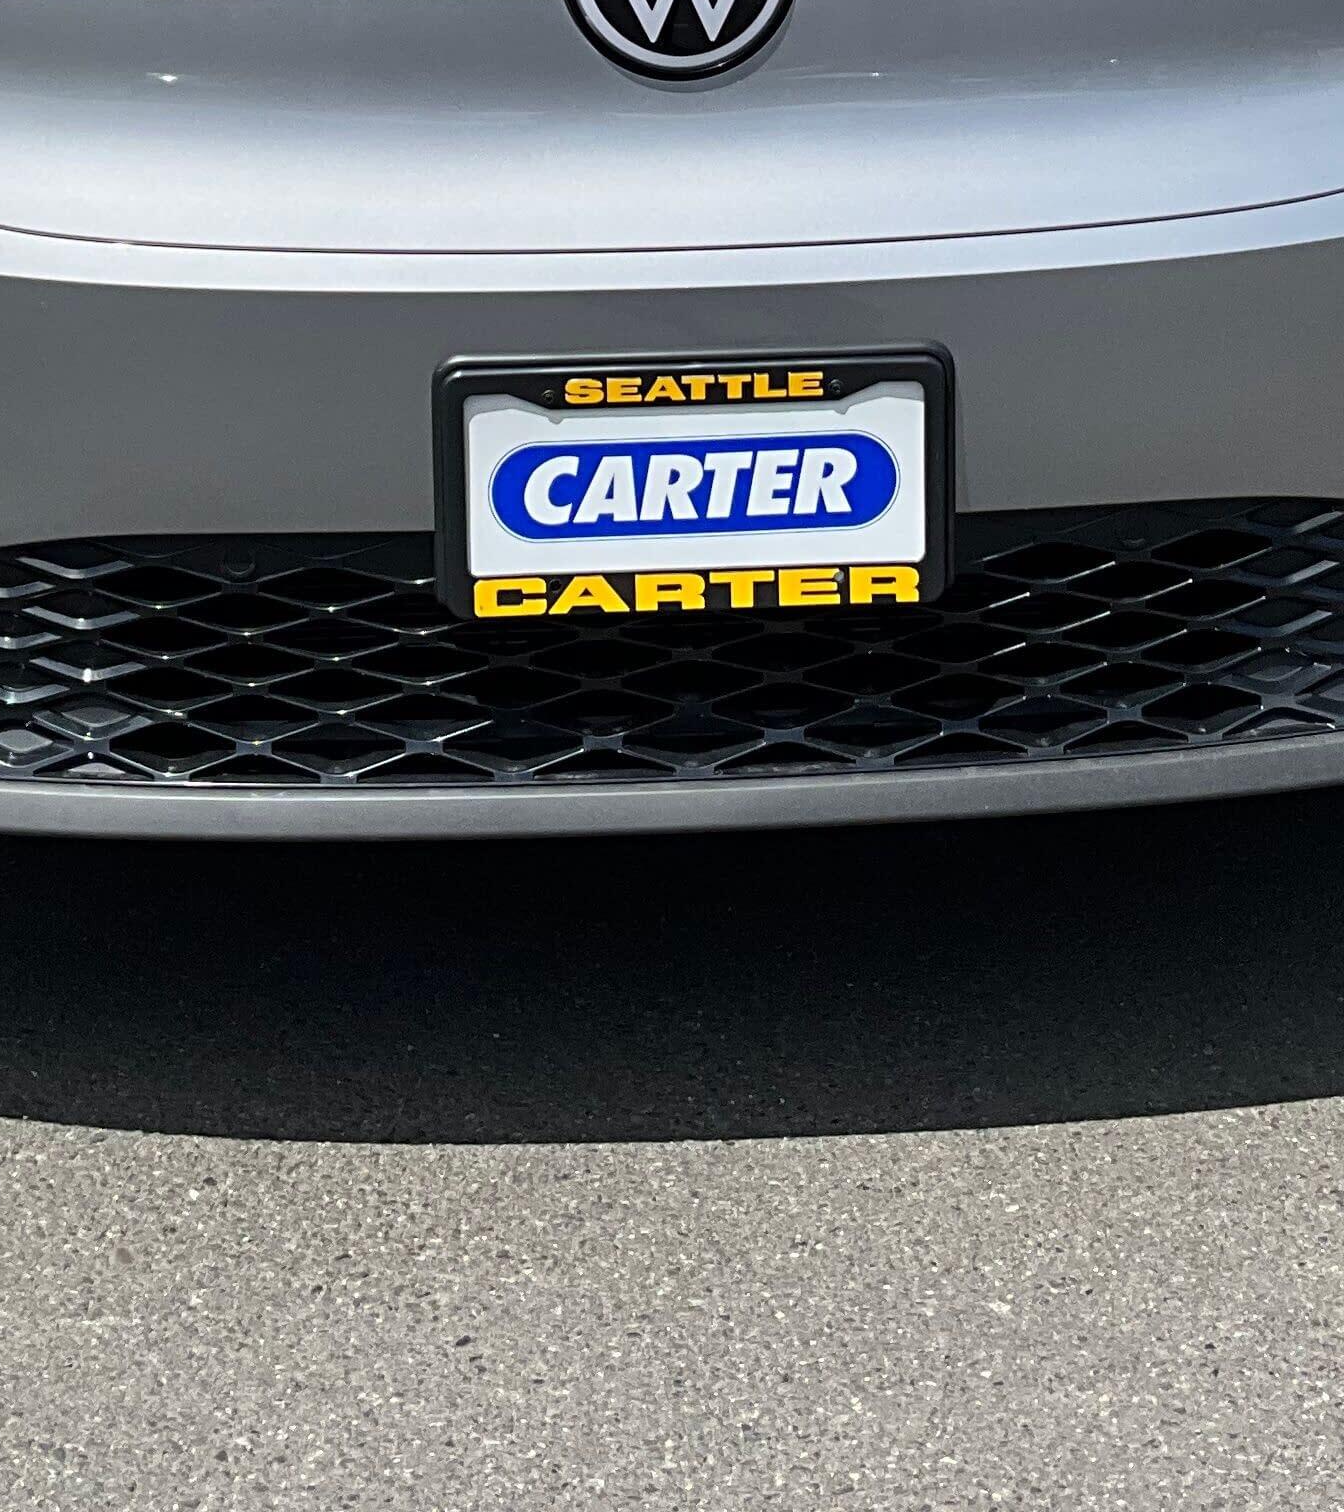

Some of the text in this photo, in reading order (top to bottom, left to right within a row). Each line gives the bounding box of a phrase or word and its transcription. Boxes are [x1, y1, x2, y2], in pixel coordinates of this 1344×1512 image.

[564, 371, 824, 405] SEATTLE
[523, 446, 858, 526] CARTER
[473, 566, 920, 619] CARTER
